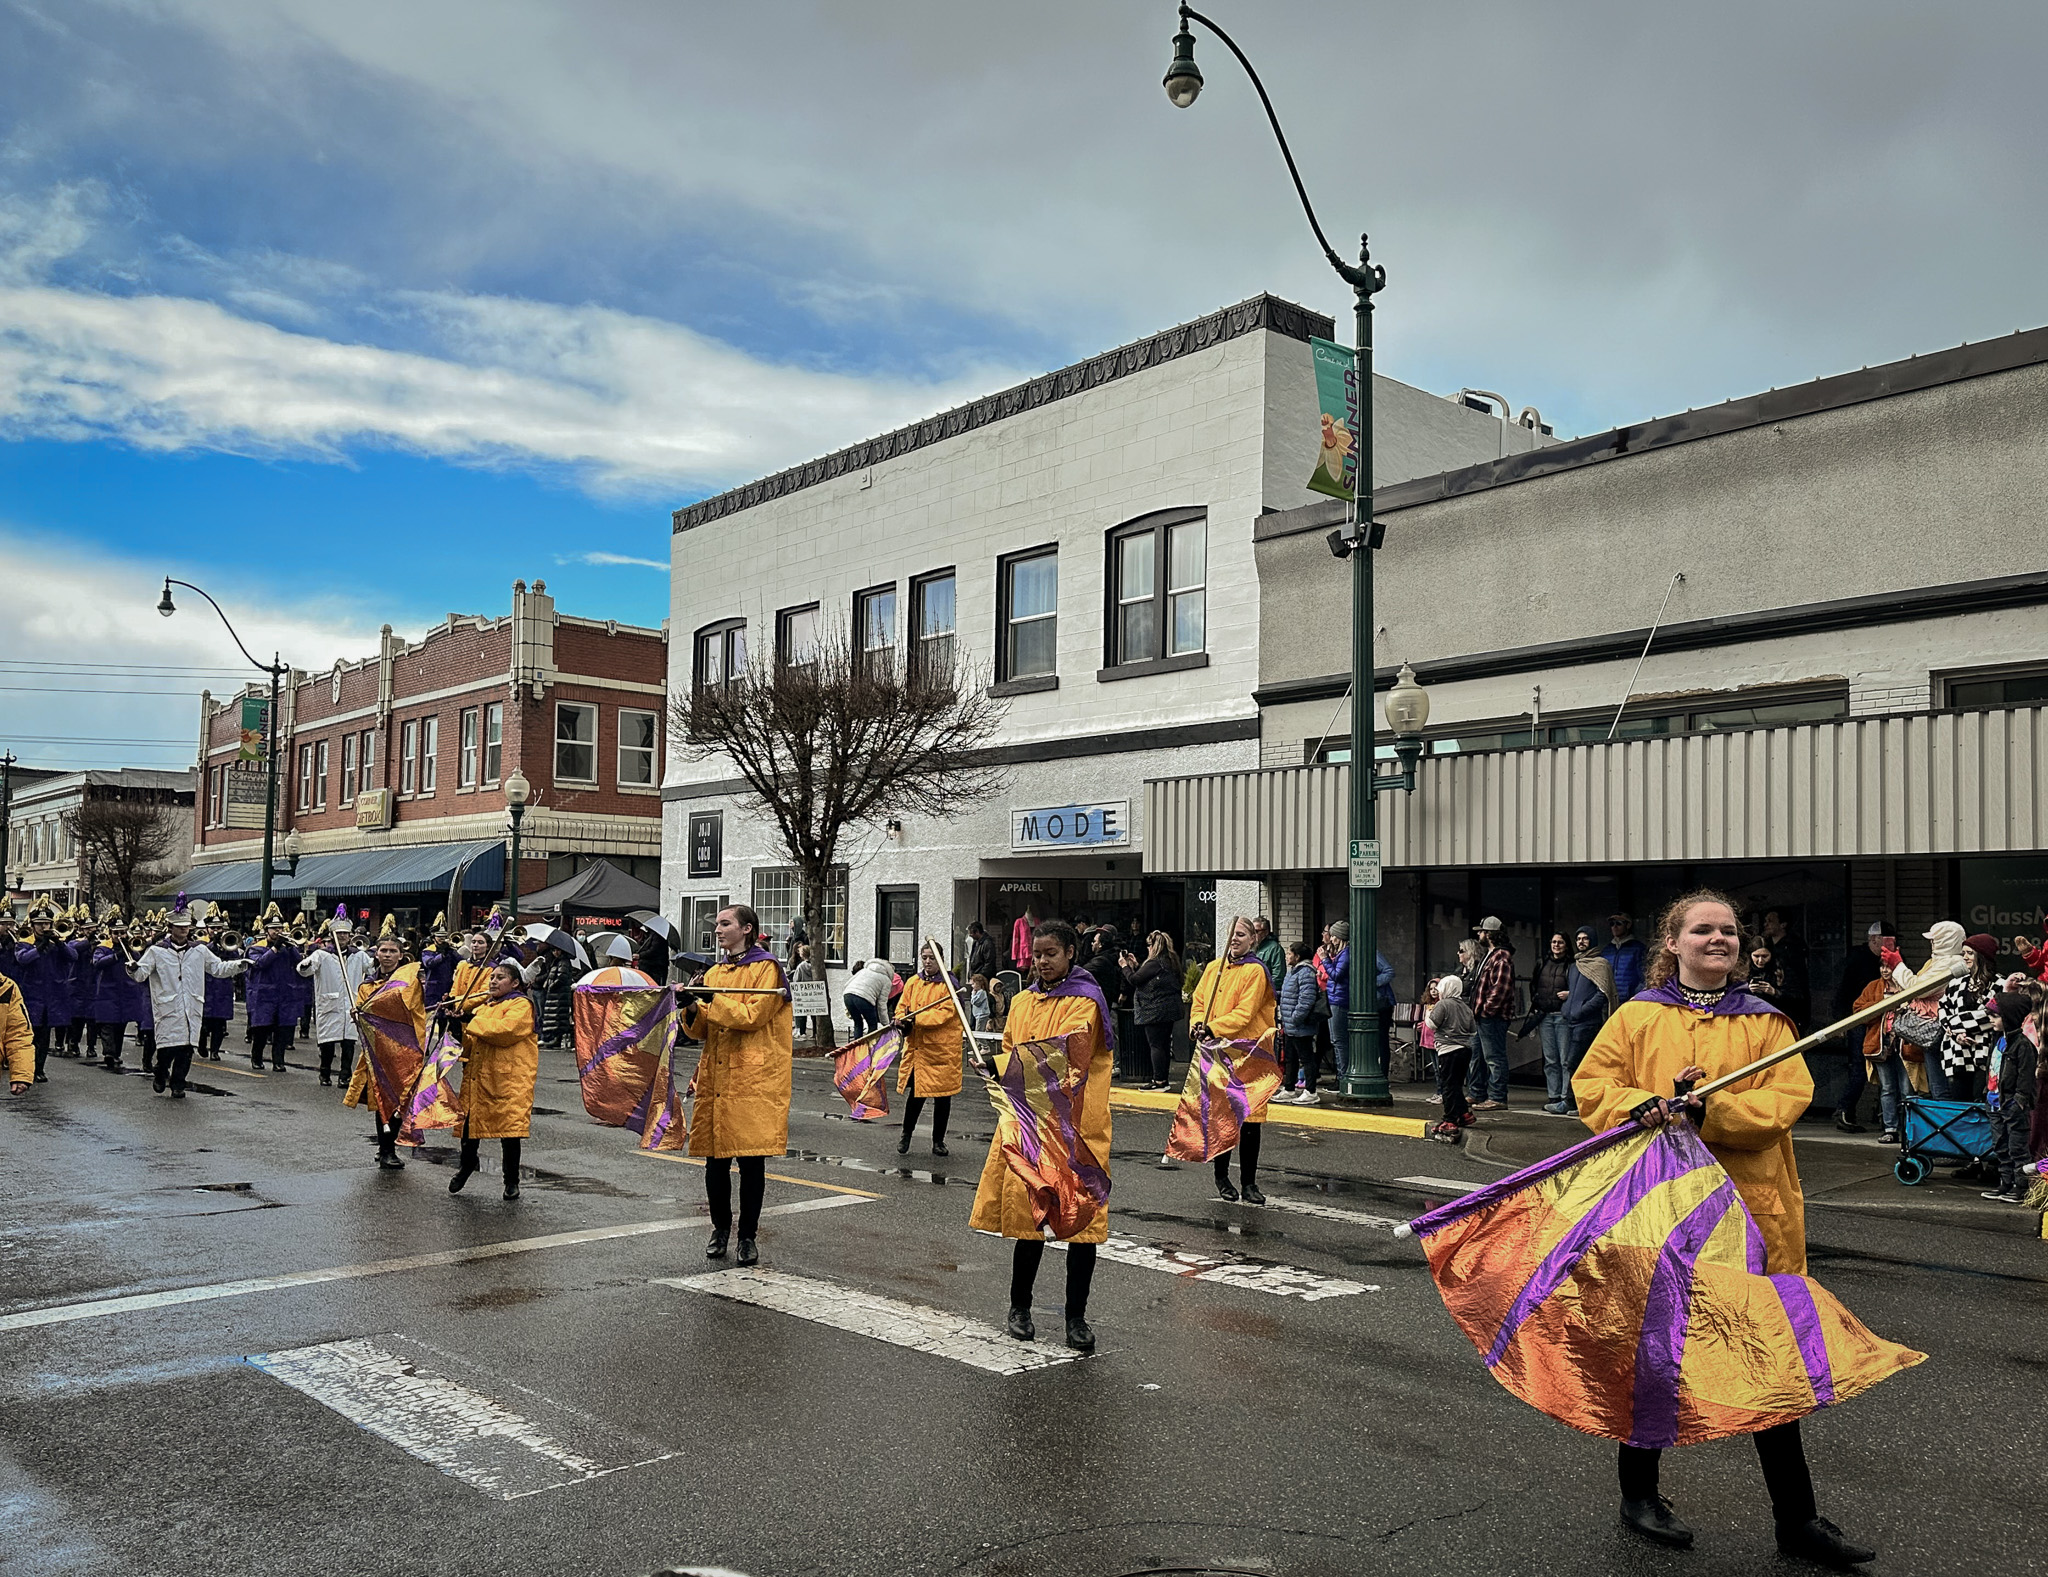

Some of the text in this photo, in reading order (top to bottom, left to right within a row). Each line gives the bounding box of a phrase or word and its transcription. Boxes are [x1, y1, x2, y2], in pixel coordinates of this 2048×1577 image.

[1343, 369, 1359, 491] SUMNER
[258, 708, 268, 757] SUMNER
[1021, 810, 1116, 841] MODE
[1351, 843, 1358, 855] 3
[1000, 883, 1043, 892] APPAREL
[1091, 883, 1115, 892] GIFT
[1199, 891, 1217, 903] ope
[575, 917, 622, 926] TO THE PUBLIC
[800, 983, 824, 991] PARKING
